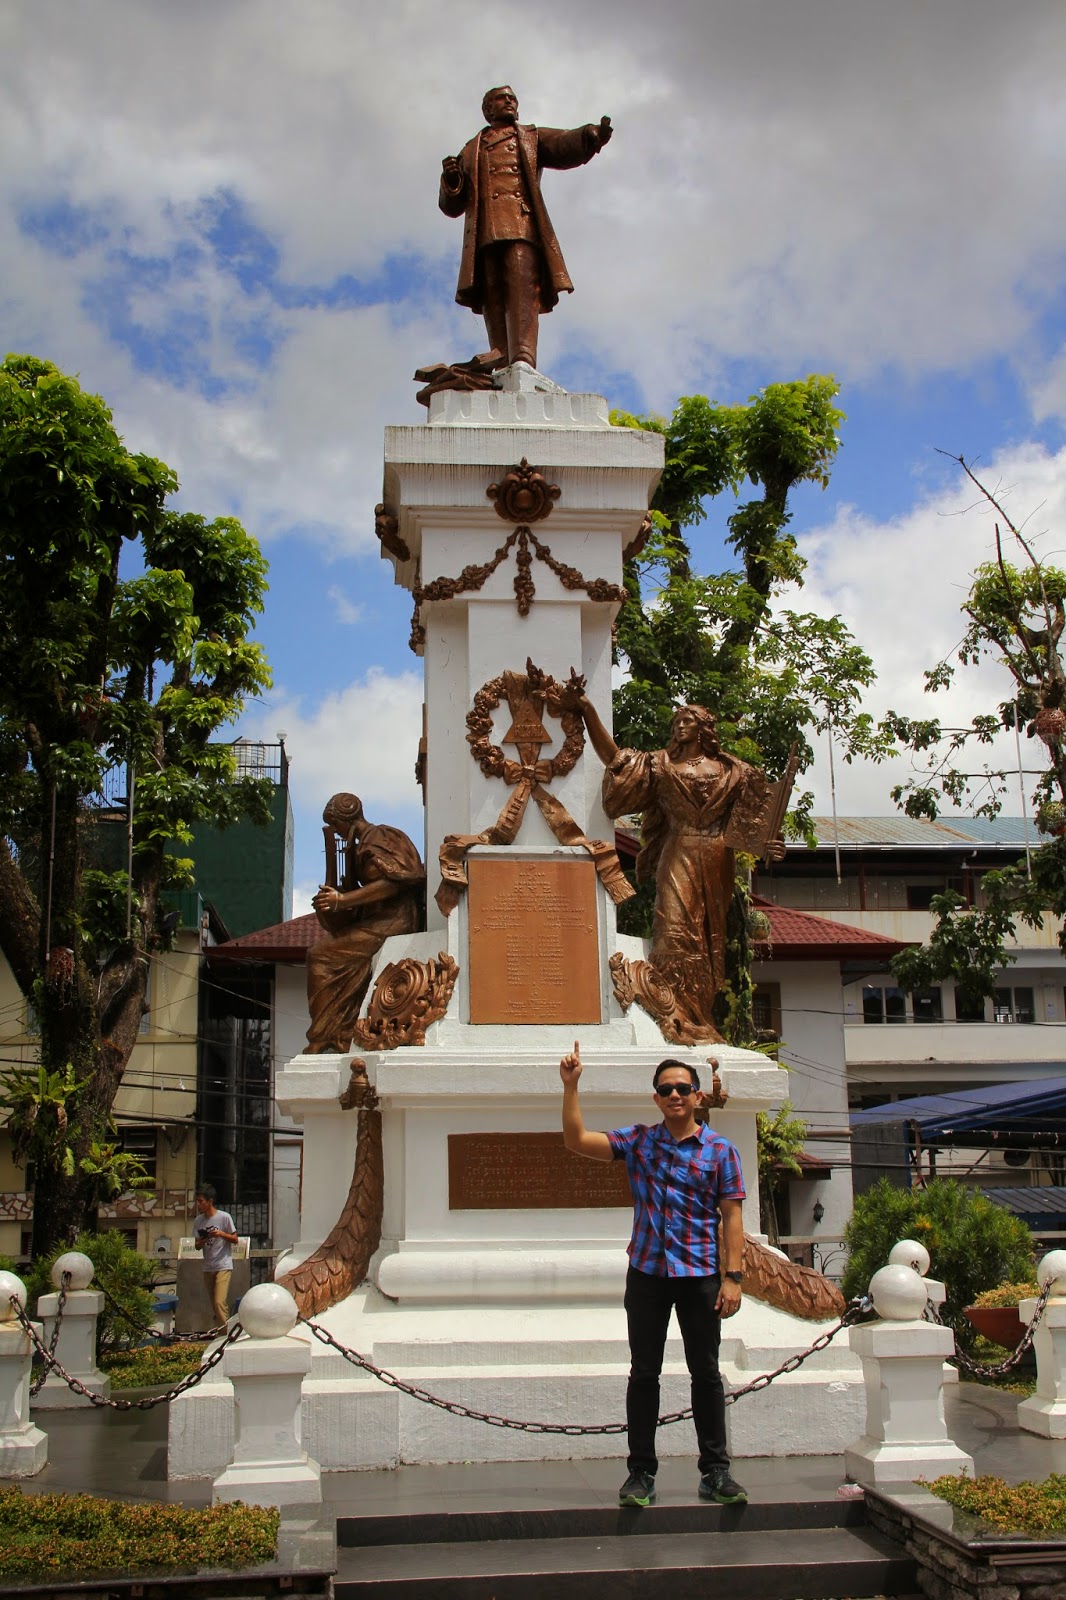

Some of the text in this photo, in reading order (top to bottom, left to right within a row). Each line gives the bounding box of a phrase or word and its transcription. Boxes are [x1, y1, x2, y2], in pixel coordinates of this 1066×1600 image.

[513, 886, 552, 894] X Y Z
